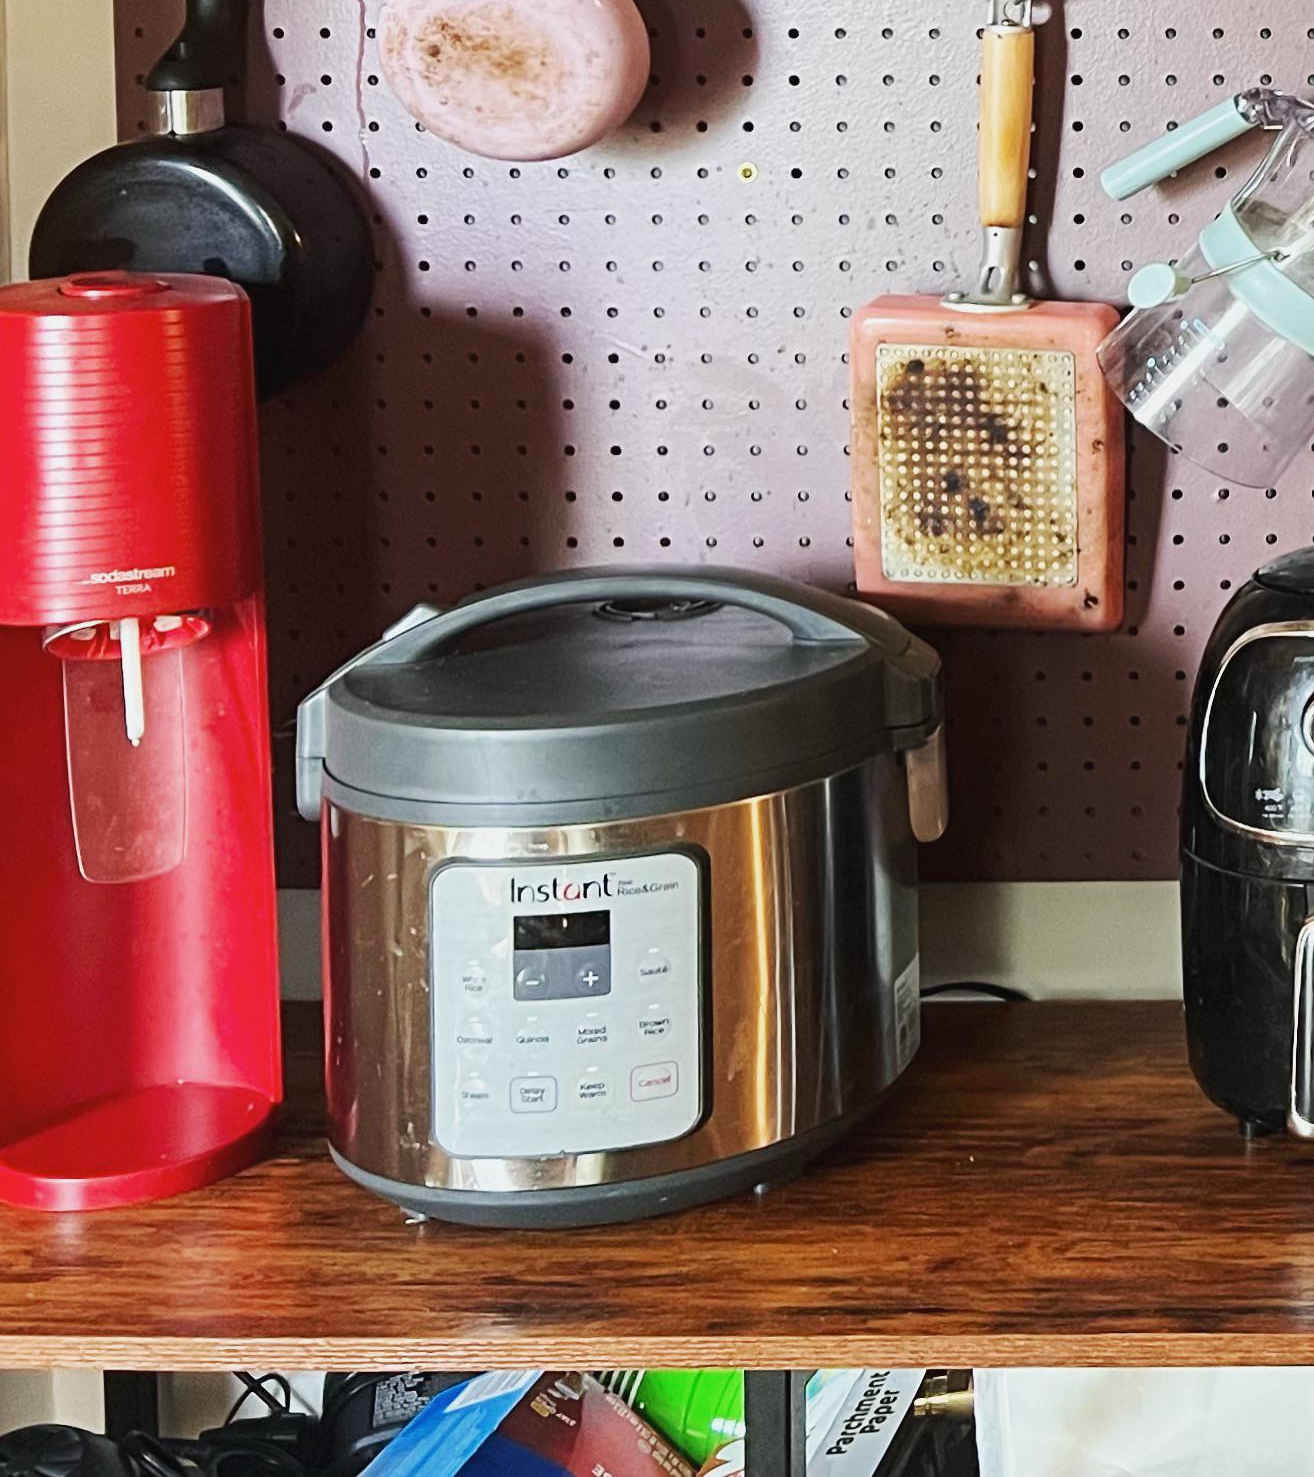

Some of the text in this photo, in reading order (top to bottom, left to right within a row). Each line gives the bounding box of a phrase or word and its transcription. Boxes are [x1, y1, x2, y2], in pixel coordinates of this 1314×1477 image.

[90, 565, 175, 584] sodastream
[116, 585, 152, 595] TERRA
[511, 873, 613, 904] Instant
[825, 1370, 891, 1455] Parchment
[859, 1390, 900, 1434] Paper
